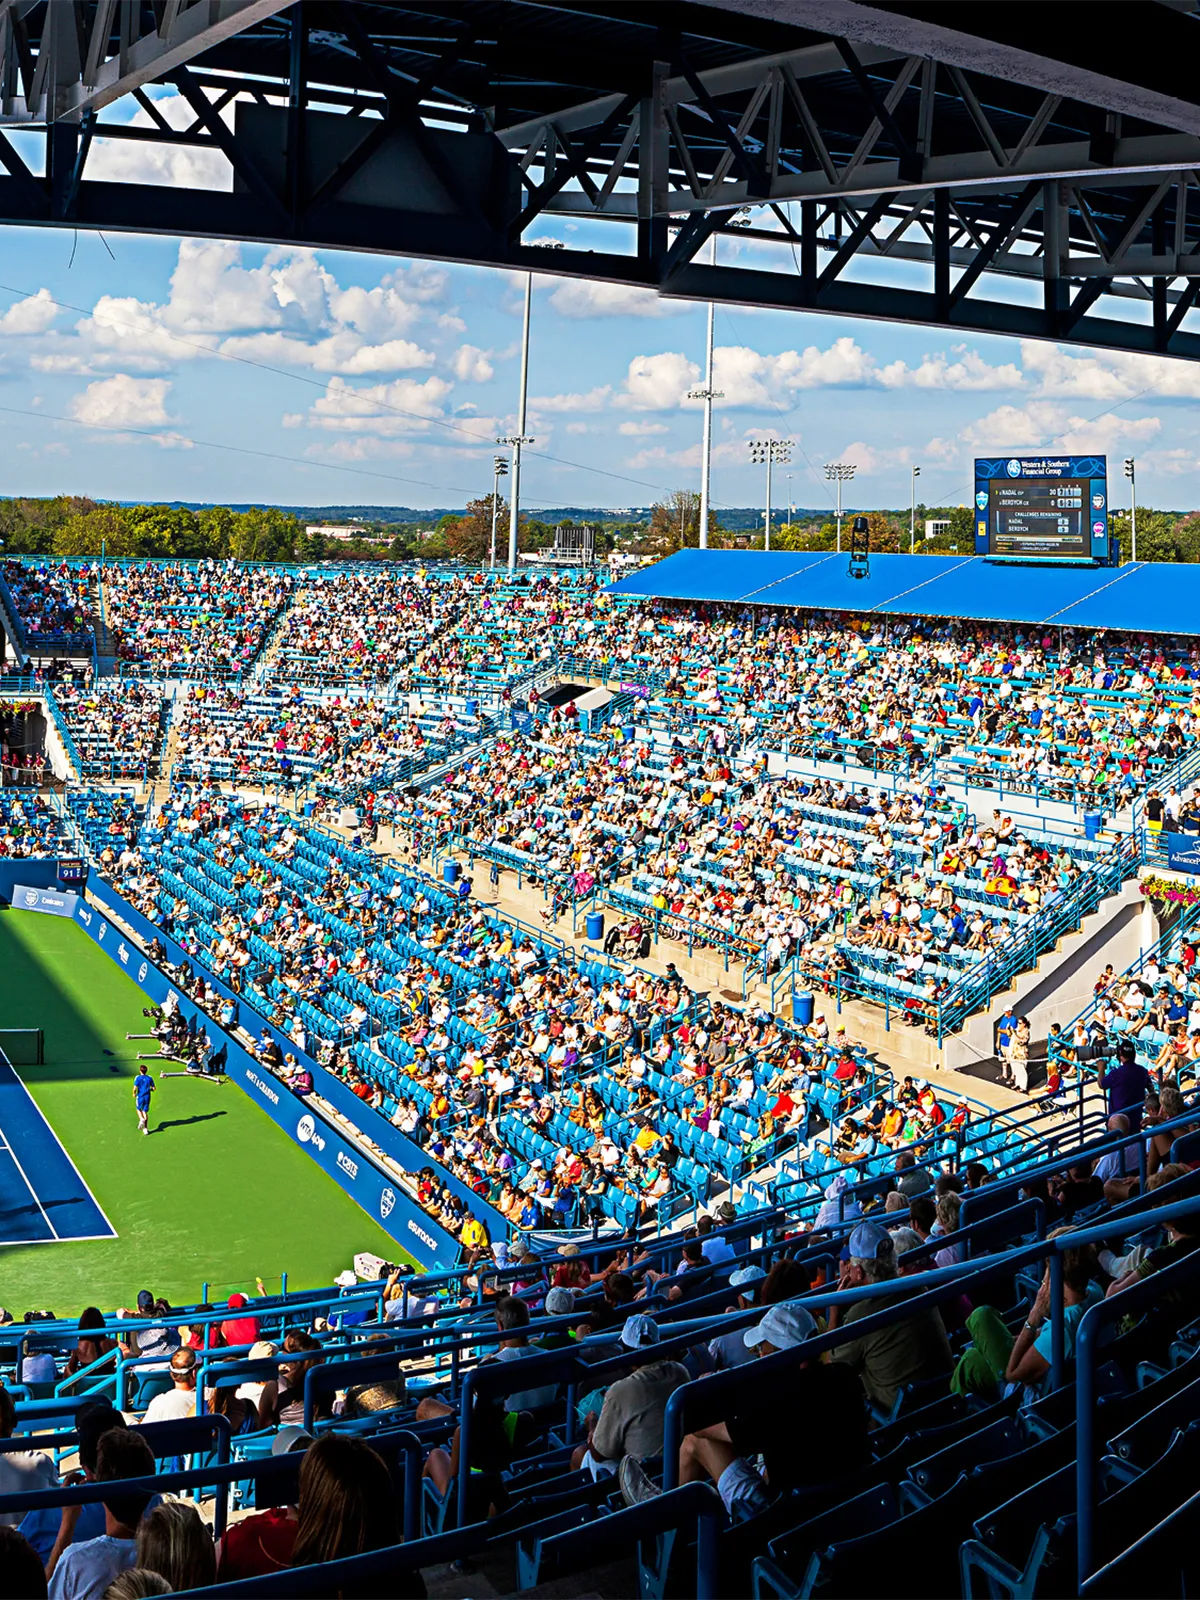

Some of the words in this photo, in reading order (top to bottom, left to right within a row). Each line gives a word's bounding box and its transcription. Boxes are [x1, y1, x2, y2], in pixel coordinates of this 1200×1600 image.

[1047, 460, 1070, 468] Southern
[1045, 468, 1062, 476] Group
[63, 869, 74, 878] 91
